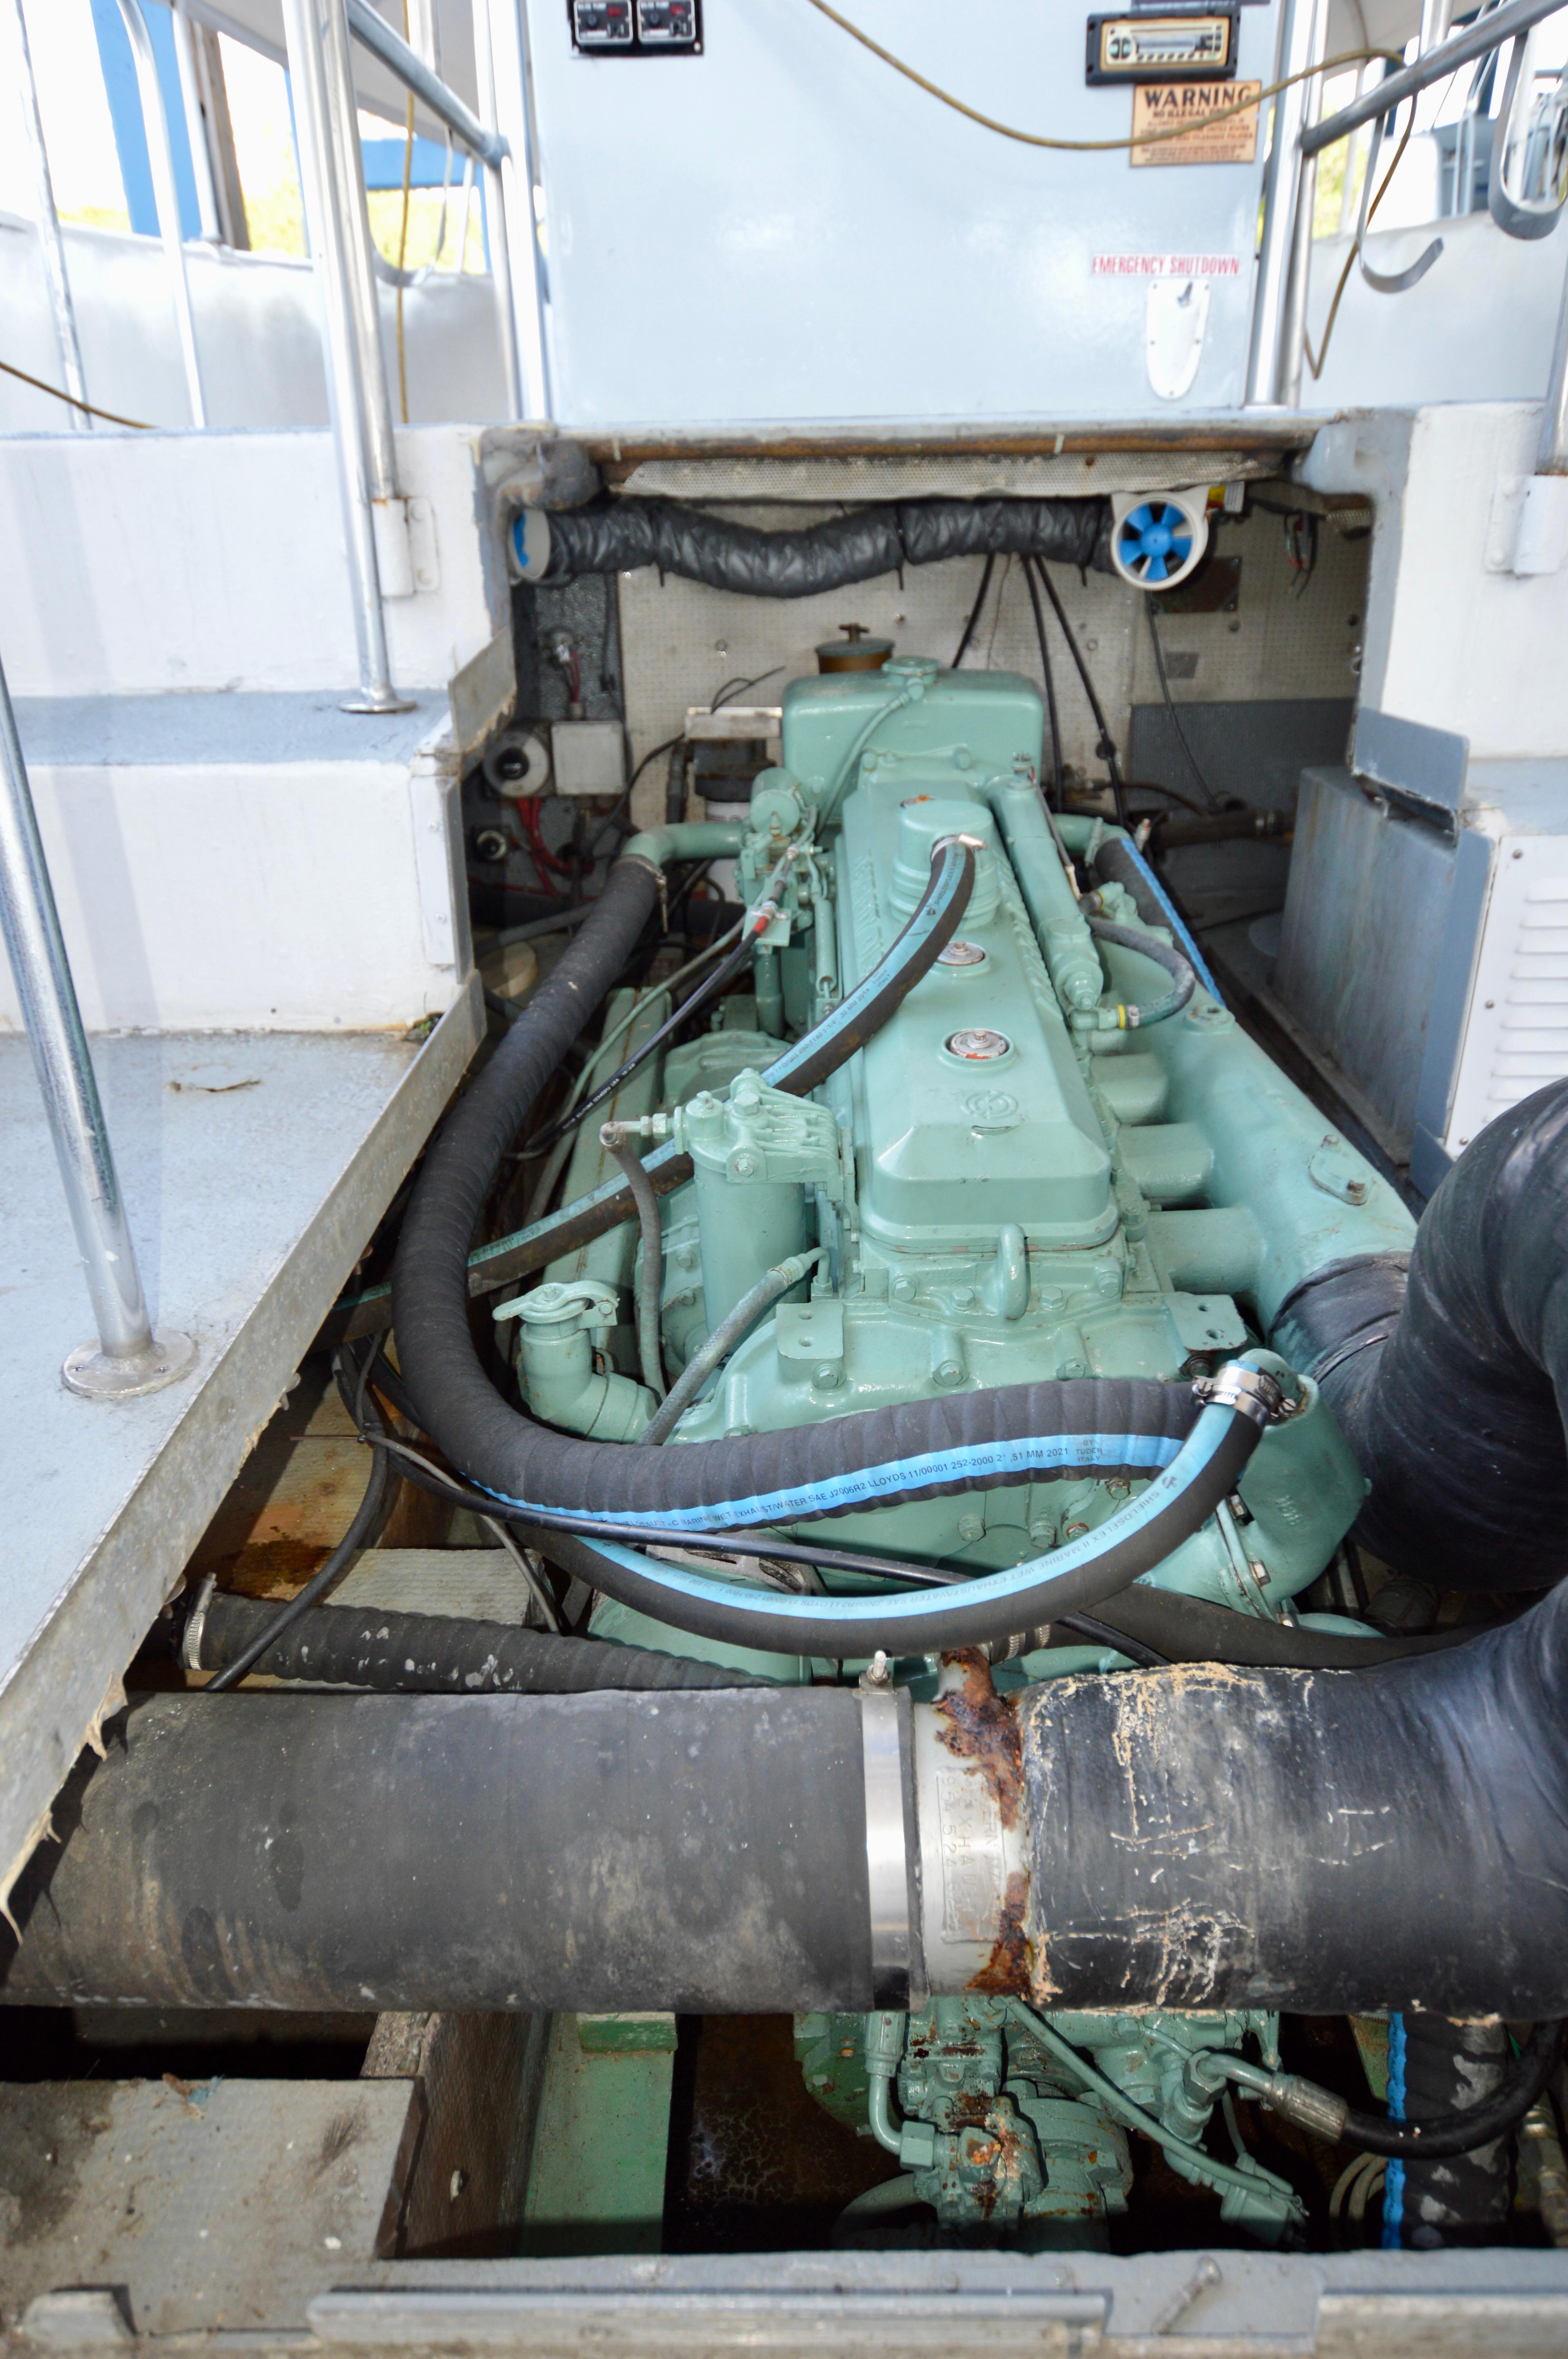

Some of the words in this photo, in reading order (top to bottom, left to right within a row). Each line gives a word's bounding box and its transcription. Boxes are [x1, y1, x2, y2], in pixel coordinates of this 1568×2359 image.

[1145, 85, 1251, 108] WARNING
[1092, 256, 1166, 274] EMERGENCY
[1169, 256, 1239, 274] SHUTDOWN
[847, 1000, 858, 1010] MM
[857, 988, 870, 1001] 2014
[681, 1516, 711, 1525] MARINE
[713, 1511, 732, 1521] WET
[734, 1496, 807, 1518] EXHAUST/WATER
[808, 1493, 827, 1502] SAE
[829, 1483, 866, 1498] J2006R2
[868, 1472, 906, 1487] LLOYDS
[909, 1465, 948, 1478] 11/00001
[952, 1455, 994, 1470] 252-2000
[1027, 1450, 1044, 1458] MM
[1047, 1447, 1068, 1458] 2021
[1092, 1491, 1160, 1543] SHIELDSFLEX
[1038, 1546, 1080, 1570] MARINE
[1010, 1567, 1034, 1579] WET
[942, 1776, 956, 1813] 954
[943, 1825, 958, 1869] 524
